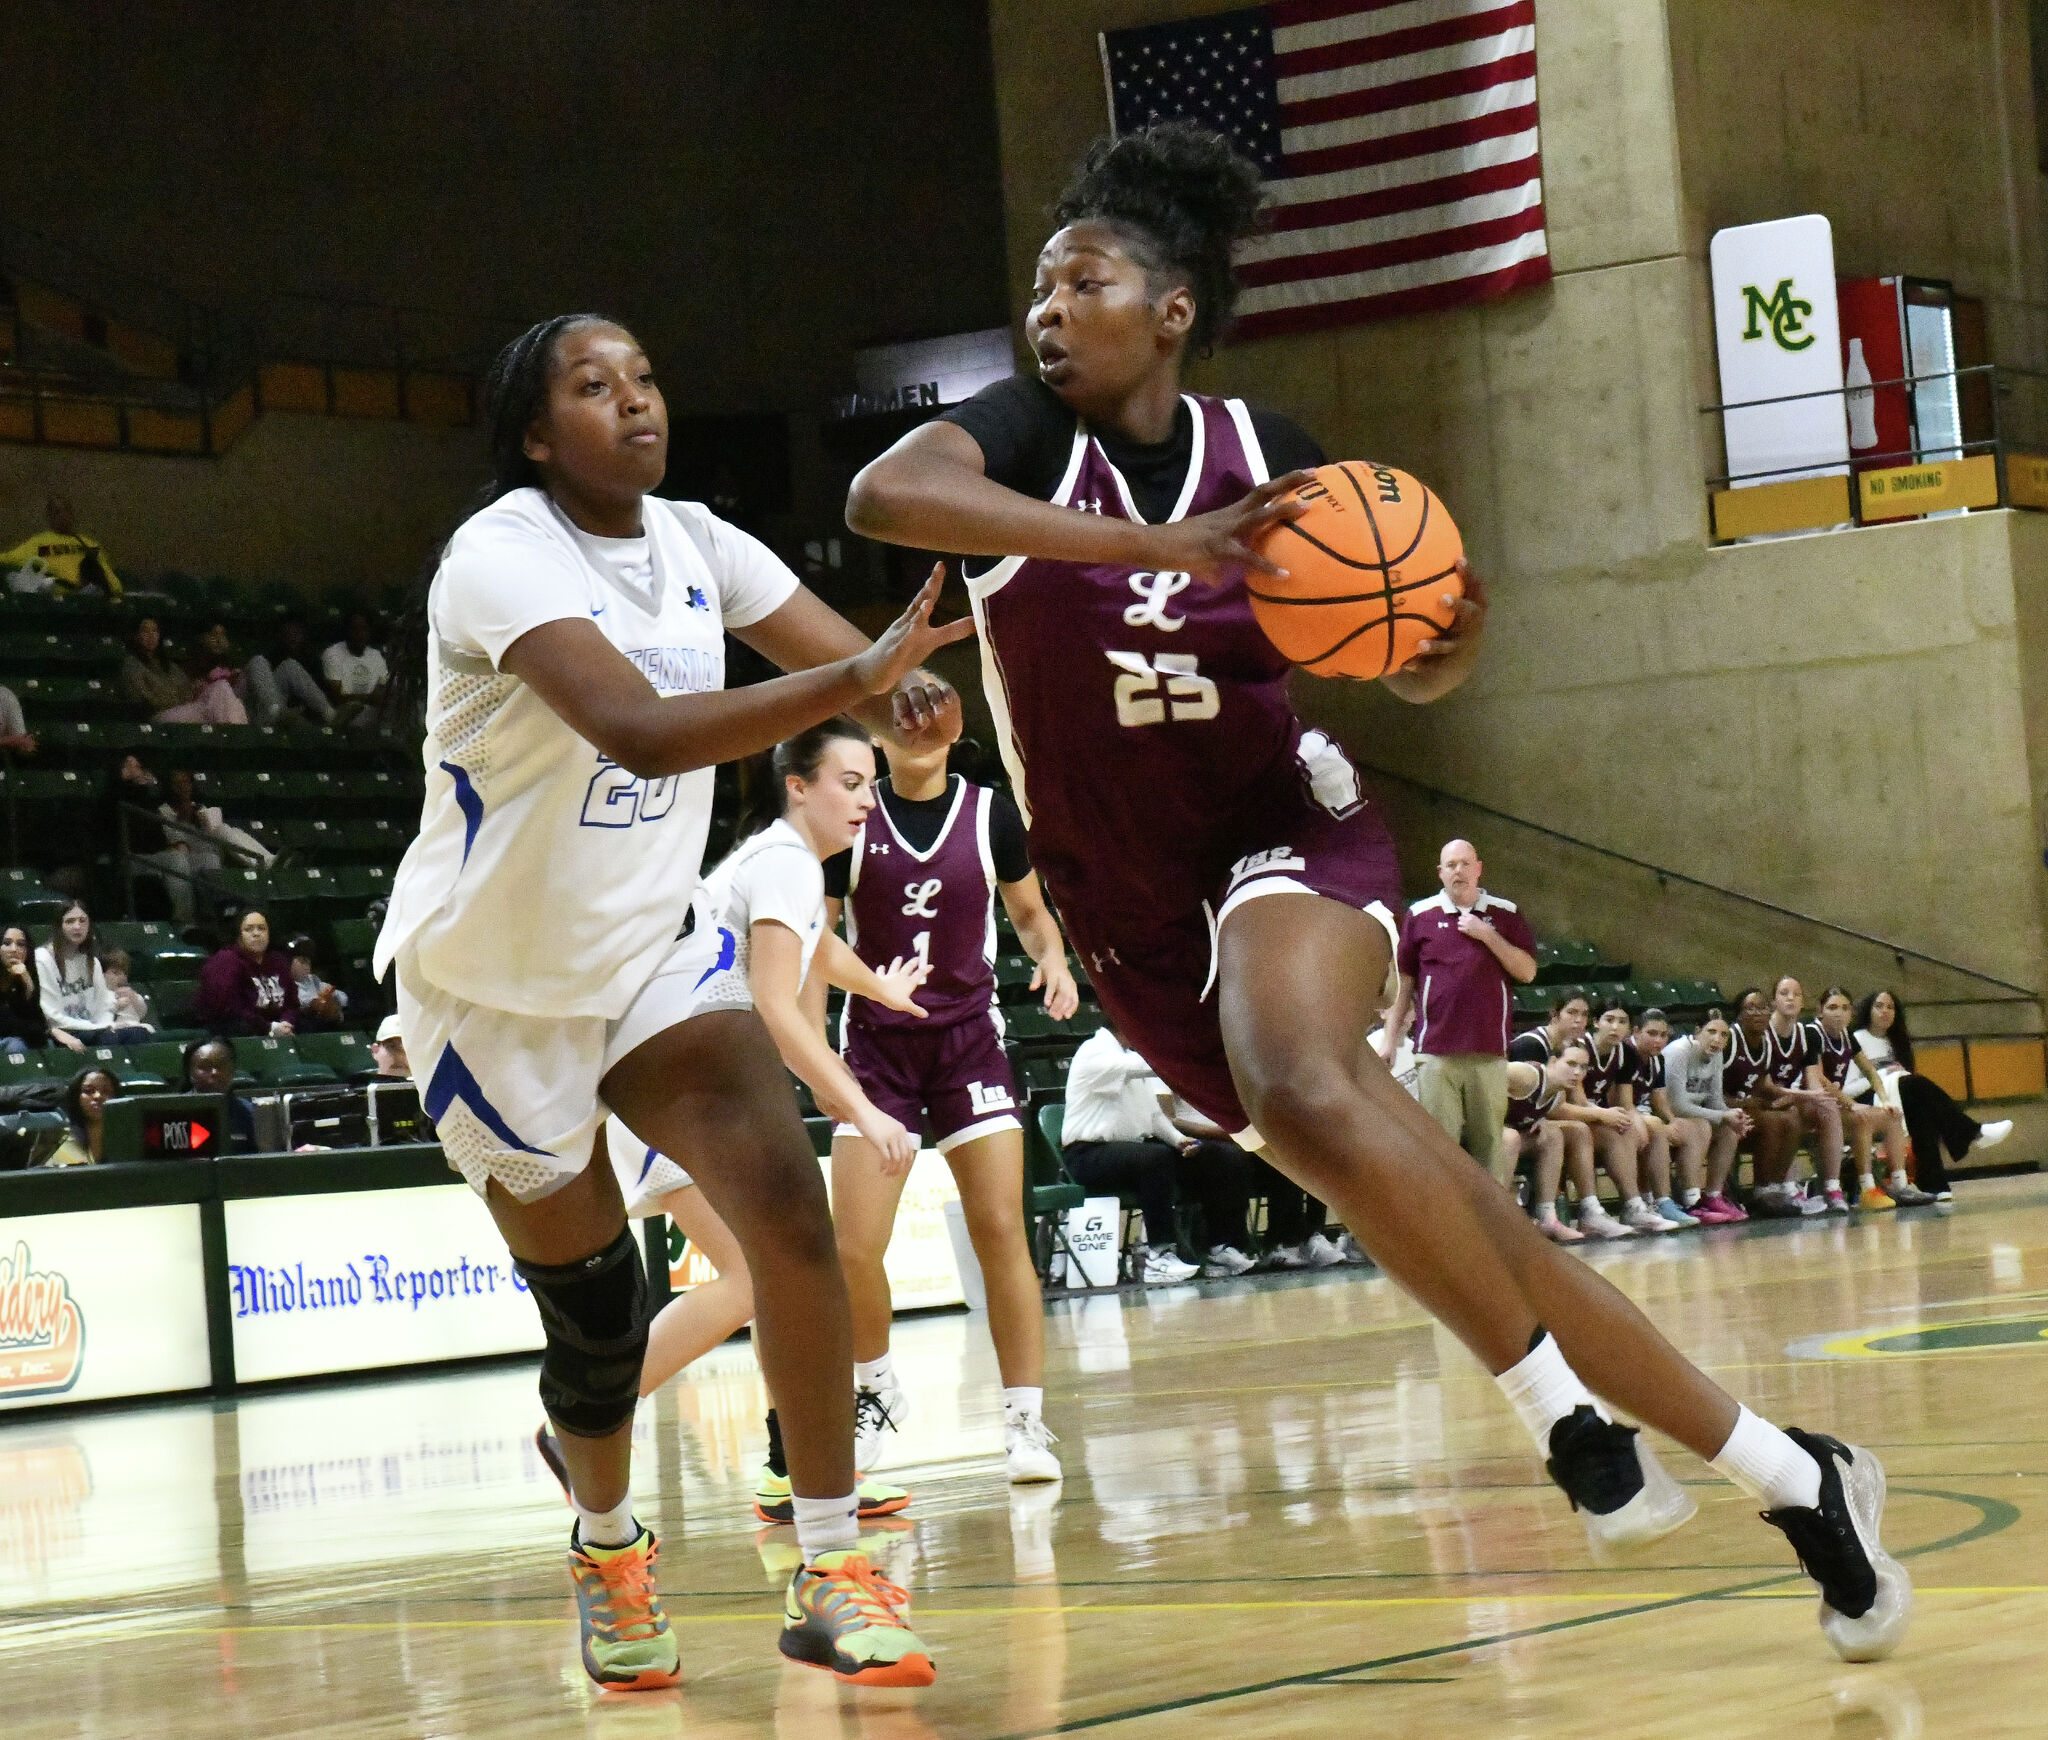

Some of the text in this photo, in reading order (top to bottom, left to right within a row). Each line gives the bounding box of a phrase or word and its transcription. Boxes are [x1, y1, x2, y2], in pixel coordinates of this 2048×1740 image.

[1870, 471, 1943, 495] NO SMOKING
[902, 878, 942, 919] L
[912, 931, 932, 986] 1
[163, 1122, 189, 1150] POSS
[1072, 1232, 1114, 1243] GAME
[1078, 1242, 1107, 1252] ONE
[228, 1264, 363, 1318] Midland
